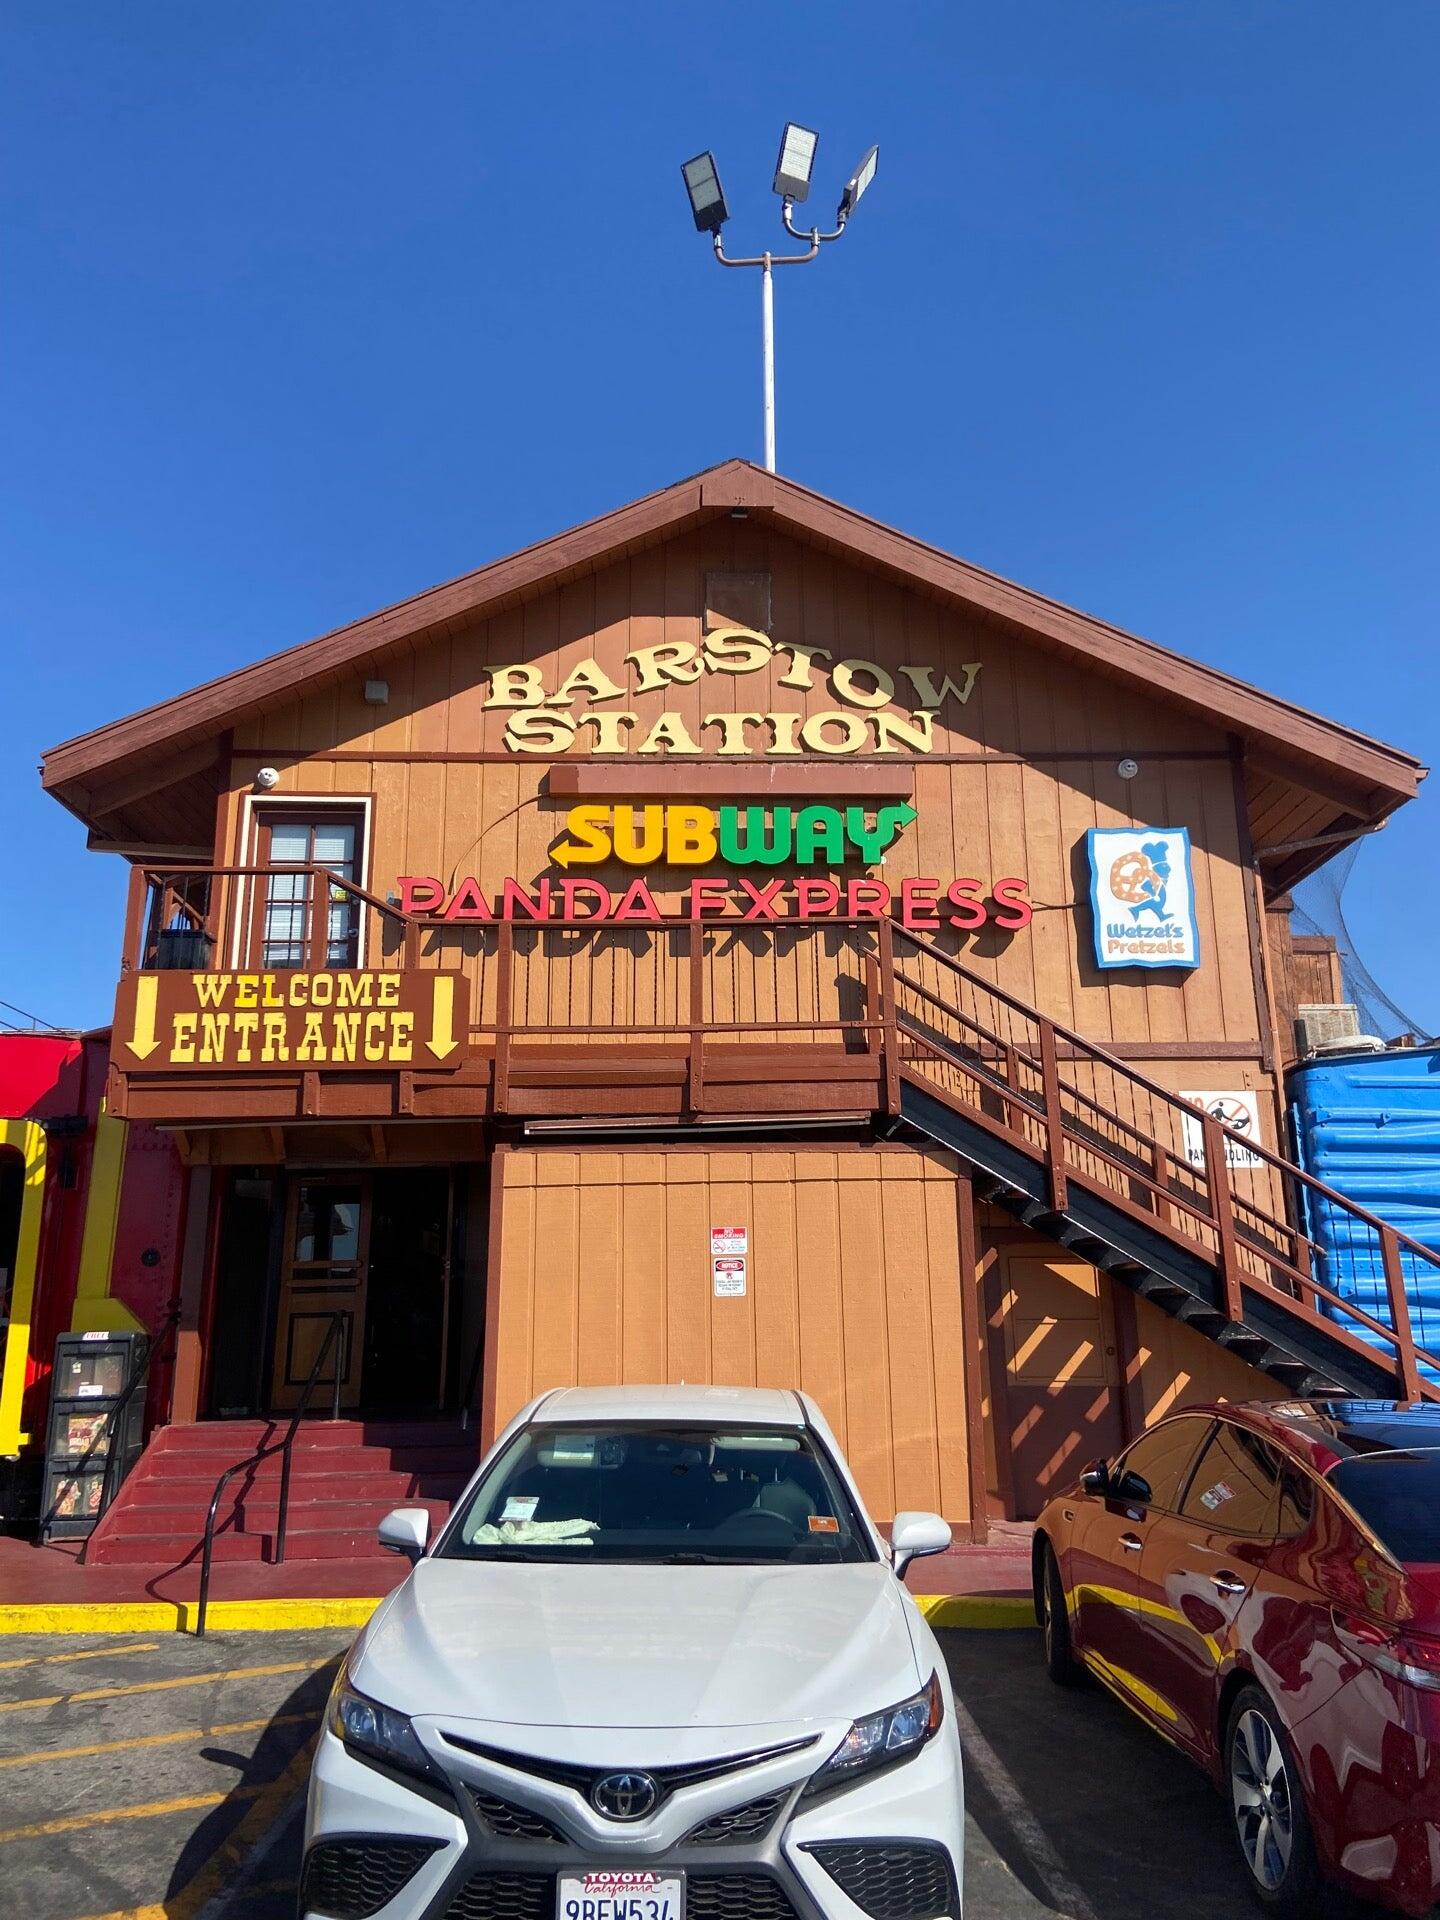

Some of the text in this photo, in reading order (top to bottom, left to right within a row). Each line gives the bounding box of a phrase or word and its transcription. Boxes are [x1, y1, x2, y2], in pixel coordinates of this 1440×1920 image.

[483, 627, 982, 710] BARSTOW
[504, 709, 940, 754] STATION
[548, 801, 918, 868] SUBWAY
[396, 876, 1034, 929] PANDA EXPRESS
[1107, 923, 1184, 939] Wetzel's
[1107, 940, 1186, 954] Pretzels
[192, 973, 401, 1008] WELCOME
[169, 1011, 414, 1063] ENTRANCE
[584, 1883, 660, 1898] California
[588, 1873, 654, 1882] TOYOTA
